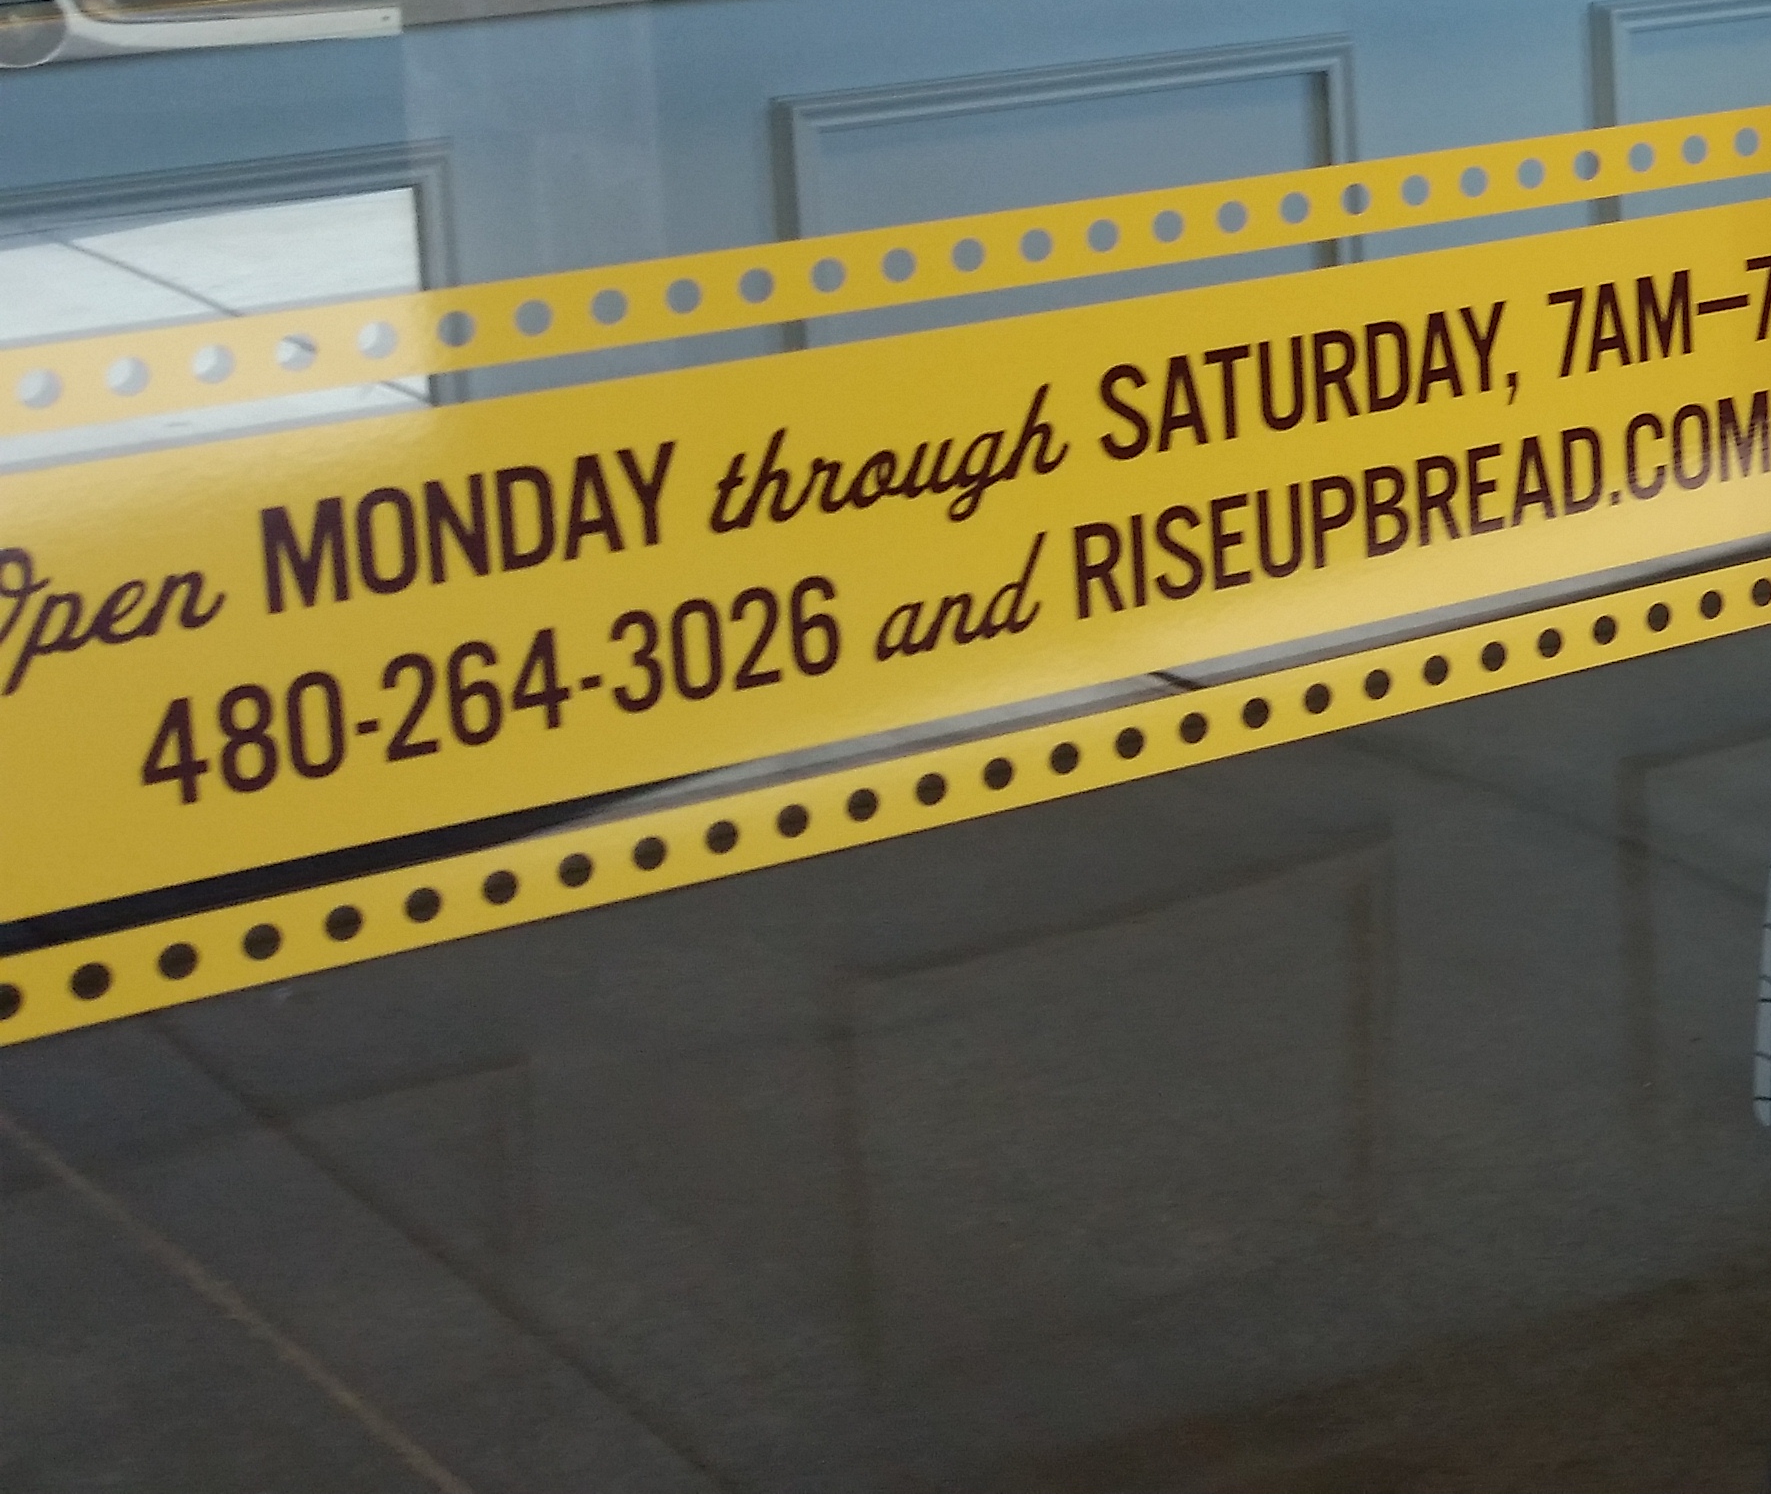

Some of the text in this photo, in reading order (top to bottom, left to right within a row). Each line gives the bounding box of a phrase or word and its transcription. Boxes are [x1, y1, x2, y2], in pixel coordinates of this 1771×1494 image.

[257, 440, 676, 616] MONDAY
[707, 384, 1070, 538] through
[1098, 299, 1521, 462] SATURDAY,
[140, 574, 840, 807] 480-264-3026
[873, 532, 1043, 661] and
